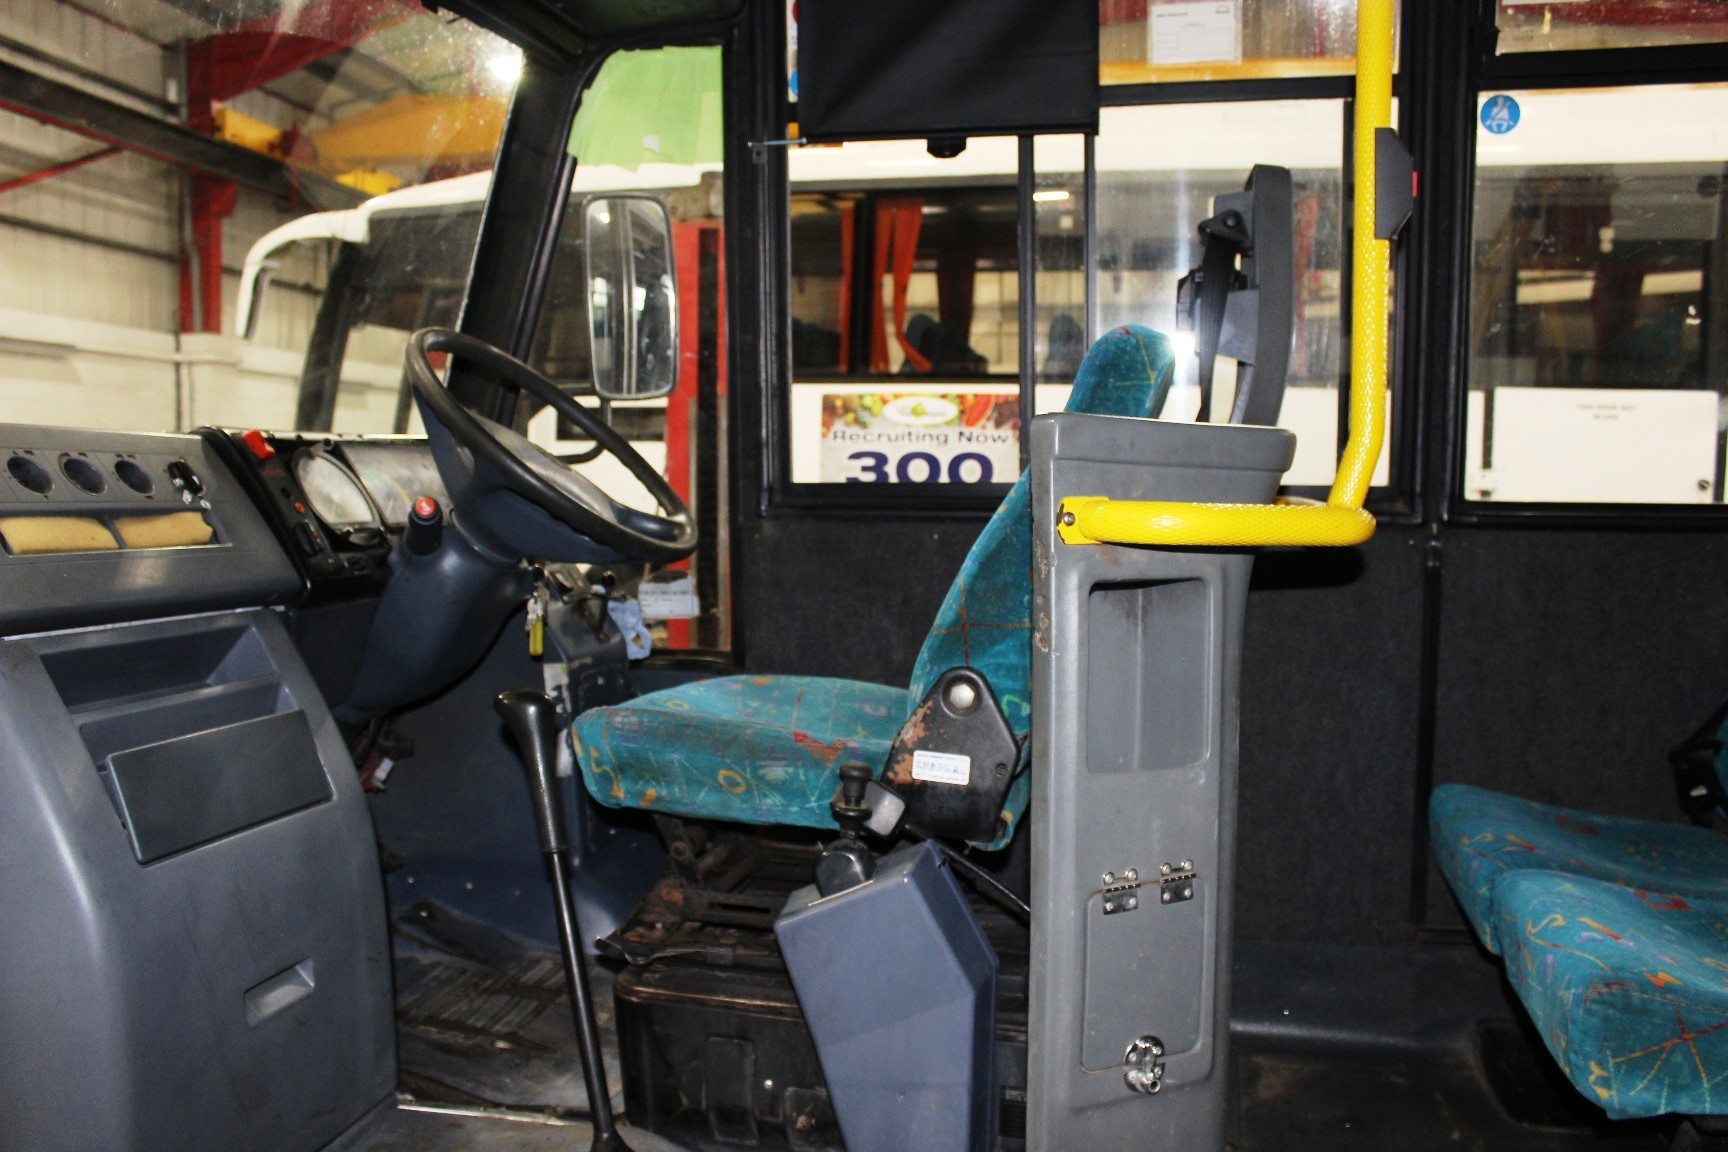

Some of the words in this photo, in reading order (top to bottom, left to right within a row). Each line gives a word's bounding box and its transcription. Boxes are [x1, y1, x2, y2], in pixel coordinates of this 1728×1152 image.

[833, 430, 949, 446] Recruiting
[957, 430, 1010, 443] Now
[846, 451, 993, 483] 300
